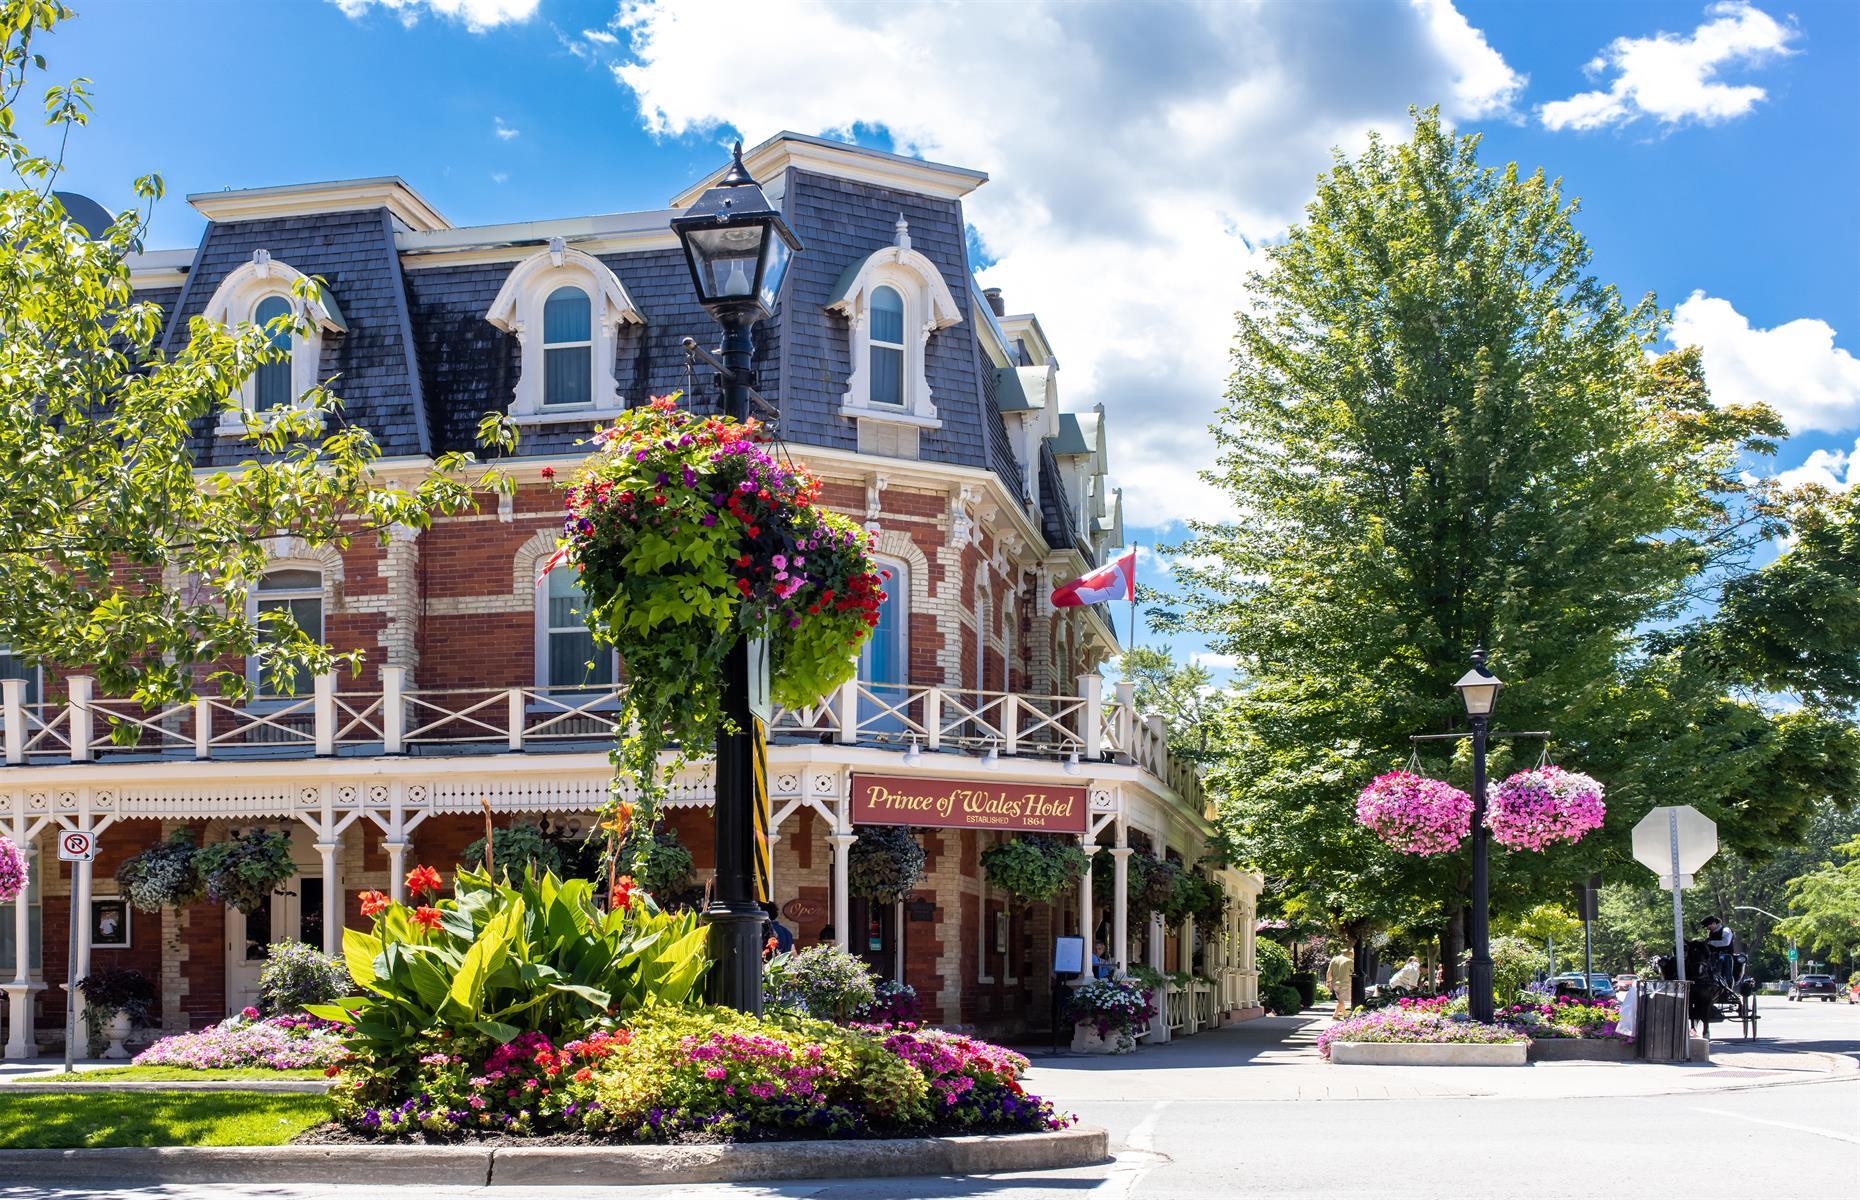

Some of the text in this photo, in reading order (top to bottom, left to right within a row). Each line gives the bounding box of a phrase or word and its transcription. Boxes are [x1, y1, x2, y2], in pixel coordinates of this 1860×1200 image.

[866, 785, 1074, 818] Prince of Wales Hotel
[966, 815, 1045, 826] ESTABLISHED 1864
